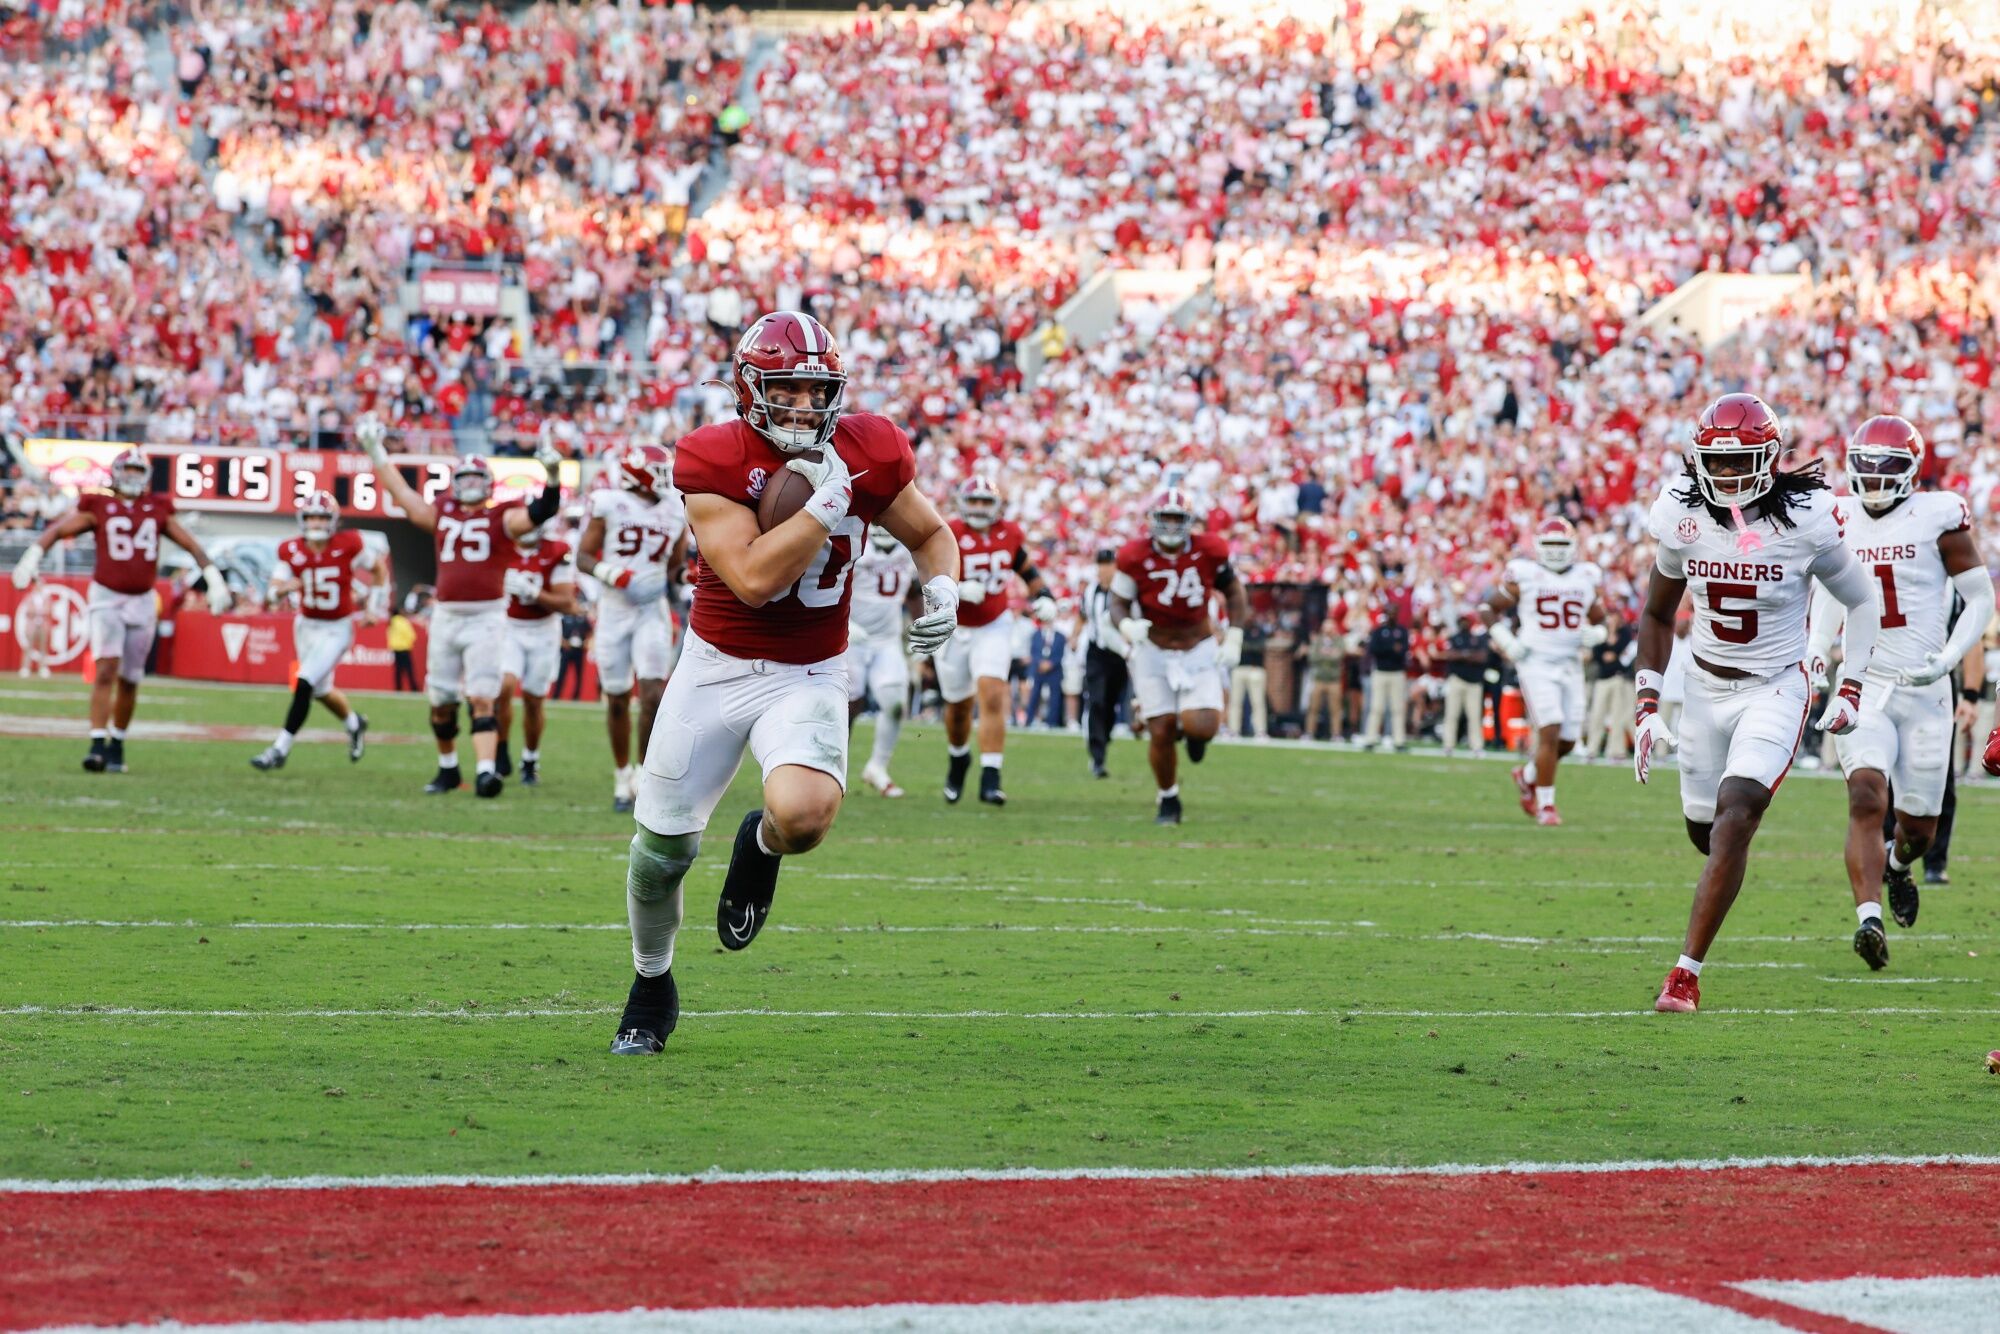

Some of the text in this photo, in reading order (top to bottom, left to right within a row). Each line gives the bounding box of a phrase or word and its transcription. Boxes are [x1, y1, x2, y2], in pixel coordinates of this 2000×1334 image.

[176, 453, 269, 500] 6:15
[294, 471, 316, 508] 3
[353, 473, 376, 511] 6
[105, 516, 159, 562] 64
[437, 516, 491, 562] 75
[615, 526, 670, 562] 97
[1854, 544, 1916, 563] ONERS
[301, 565, 341, 611] 15
[963, 550, 1012, 595] 56
[1147, 566, 1206, 608] 74
[1687, 559, 1784, 582] SOONERS
[1536, 595, 1584, 629] 56
[1706, 582, 1759, 644] 5
[1874, 564, 1907, 629] 1
